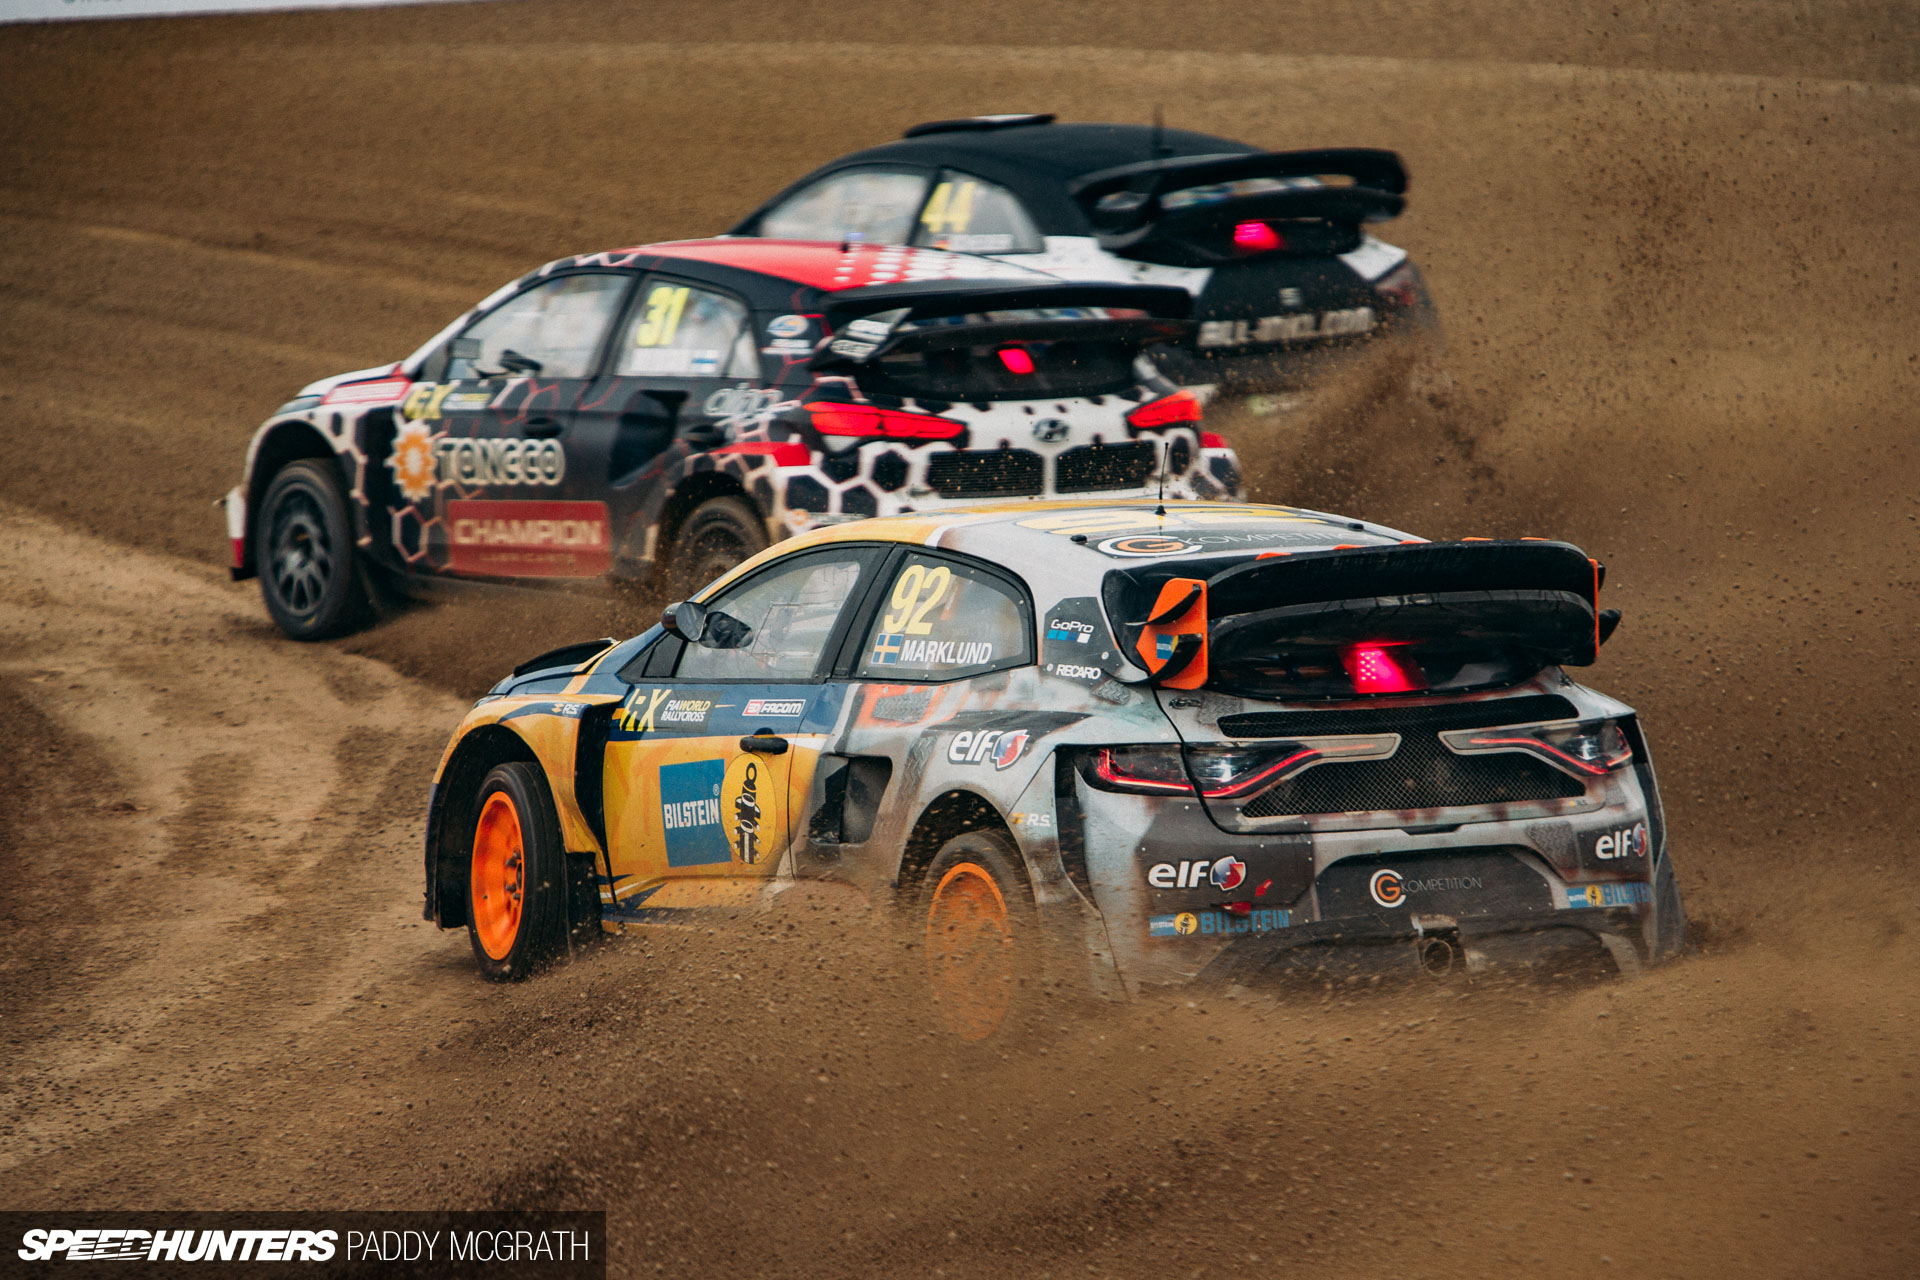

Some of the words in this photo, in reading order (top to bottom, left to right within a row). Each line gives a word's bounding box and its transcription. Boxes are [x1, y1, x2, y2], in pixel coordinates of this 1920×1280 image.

[920, 180, 978, 234] 44
[636, 286, 691, 347] 31
[453, 518, 602, 546] CHAMPION
[883, 564, 952, 635] 92
[1050, 618, 1095, 633] GoPro
[900, 639, 993, 665] MARKLUND
[1055, 664, 1101, 679] RECARO
[660, 710, 706, 722] RALLYCROSS
[760, 702, 802, 714] FACOM
[948, 728, 1004, 763] elf
[663, 798, 720, 829] BILSTEIN
[1594, 829, 1633, 859] elf
[1148, 860, 1210, 888] elf
